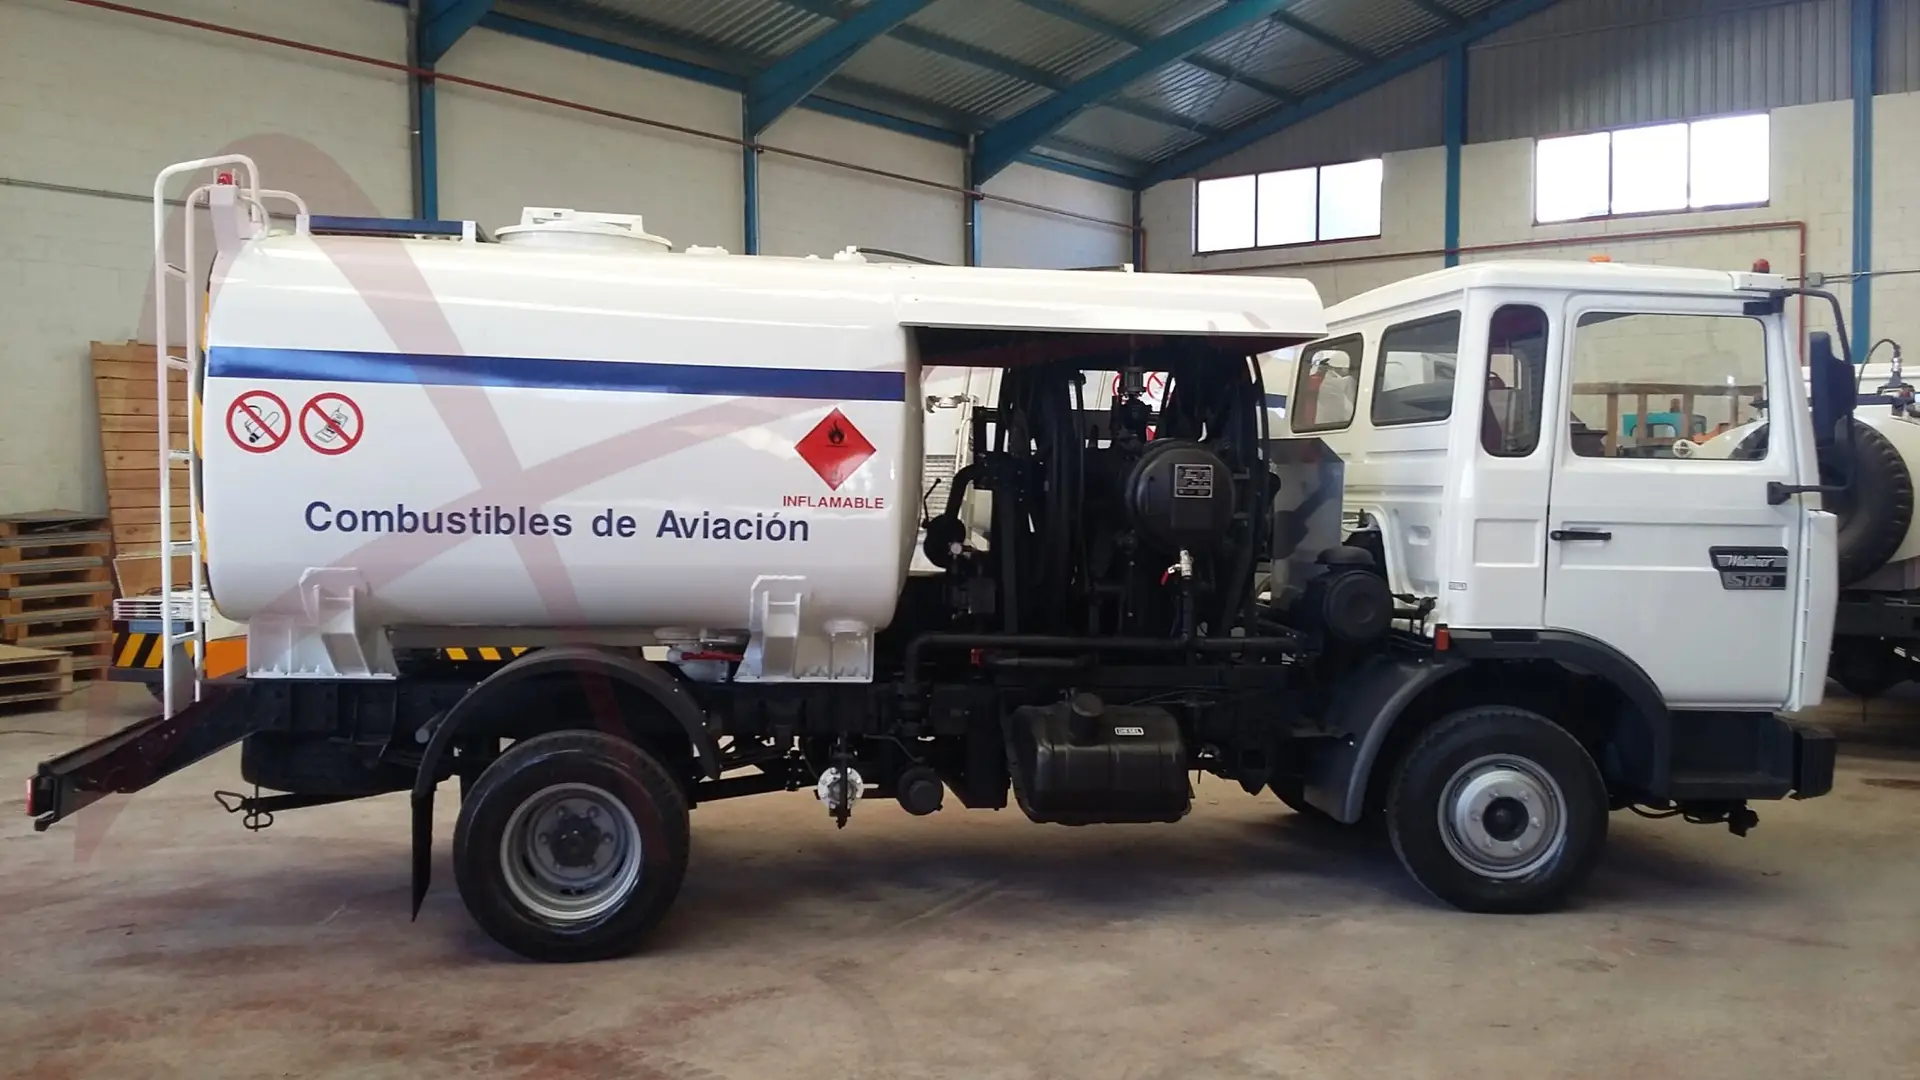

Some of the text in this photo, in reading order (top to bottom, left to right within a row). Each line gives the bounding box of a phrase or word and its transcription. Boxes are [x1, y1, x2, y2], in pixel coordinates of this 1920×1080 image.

[782, 495, 884, 509] INFLAMABLE
[304, 501, 809, 541] Combustibles de Aviación
